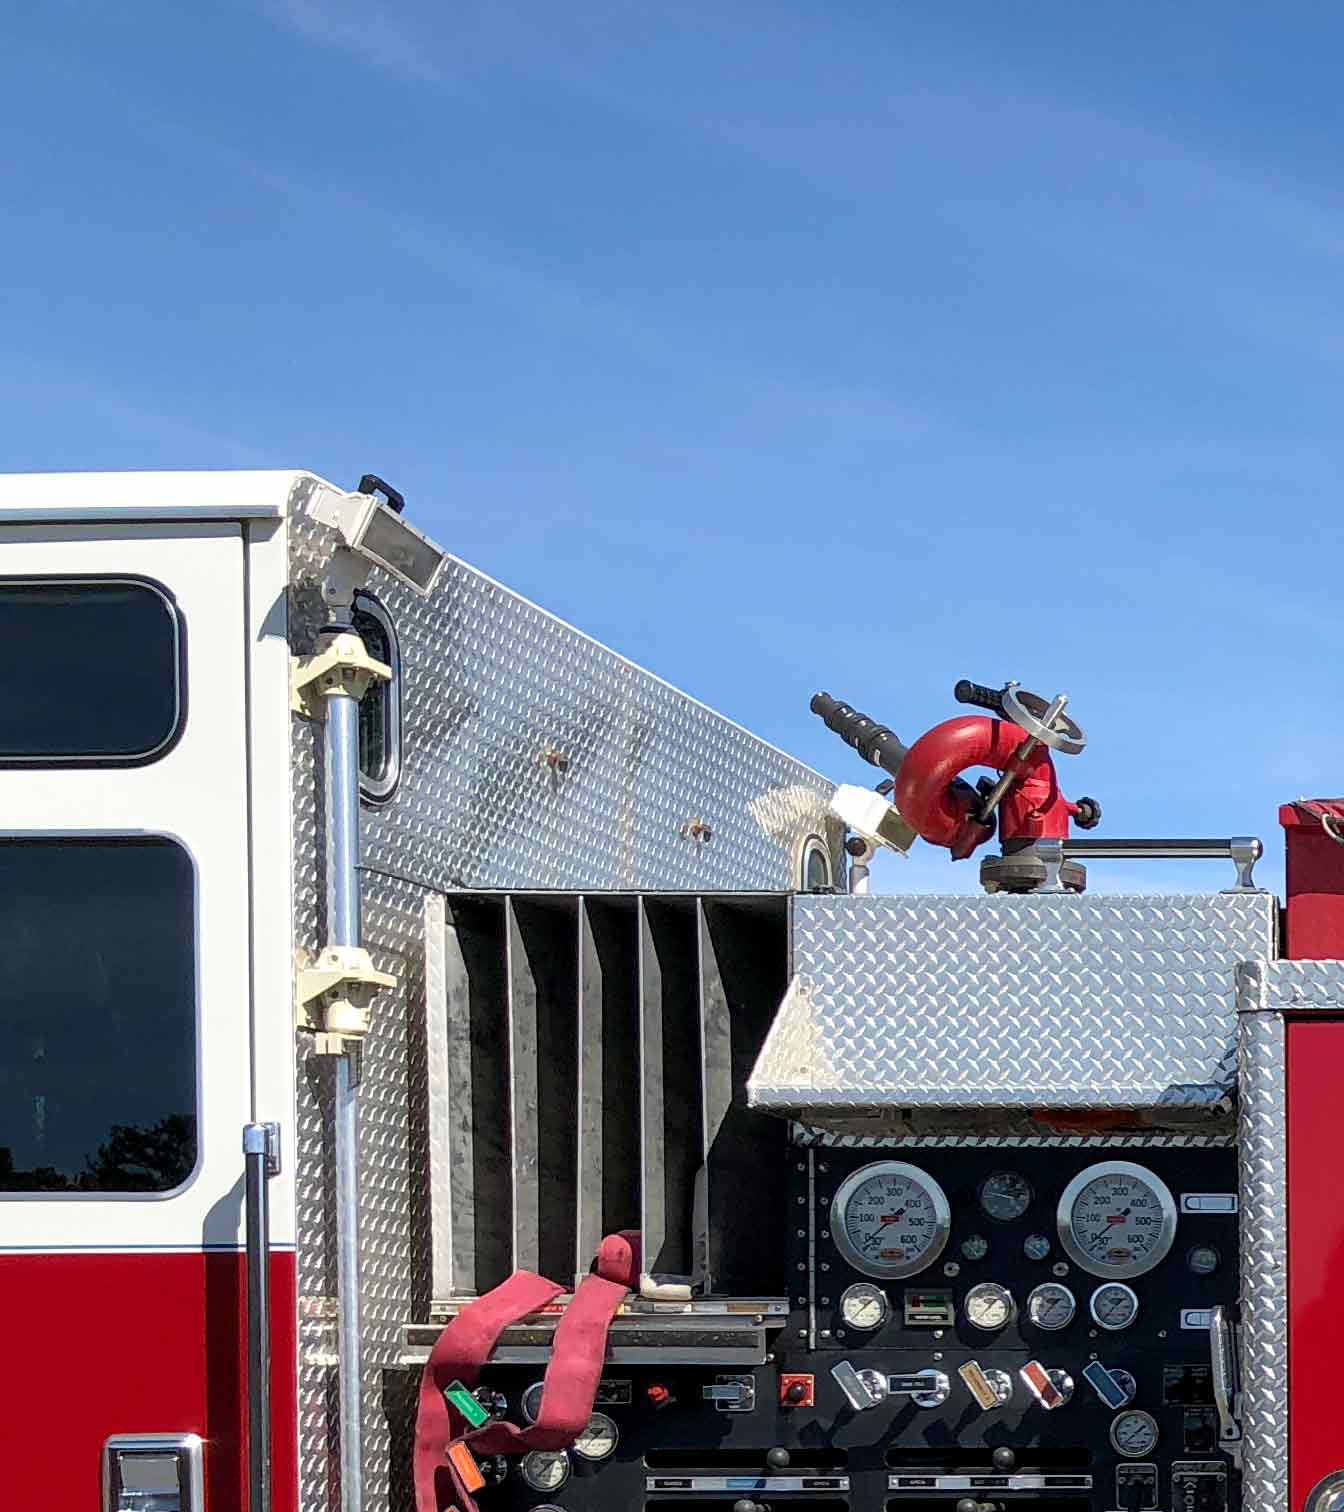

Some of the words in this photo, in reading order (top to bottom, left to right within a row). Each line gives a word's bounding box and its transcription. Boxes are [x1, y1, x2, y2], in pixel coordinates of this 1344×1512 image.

[886, 1187, 903, 1197] 300
[1111, 1187, 1128, 1196] 300
[868, 1196, 885, 1205] 200
[905, 1199, 921, 1208] 400
[1094, 1196, 1111, 1205] 200
[1130, 1199, 1147, 1207] 400
[860, 1214, 875, 1222] 100
[908, 1217, 925, 1226] 500
[1086, 1214, 1100, 1222] 100
[1135, 1216, 1151, 1225] 500
[900, 1234, 917, 1243] 600
[1128, 1234, 1144, 1243] 600
